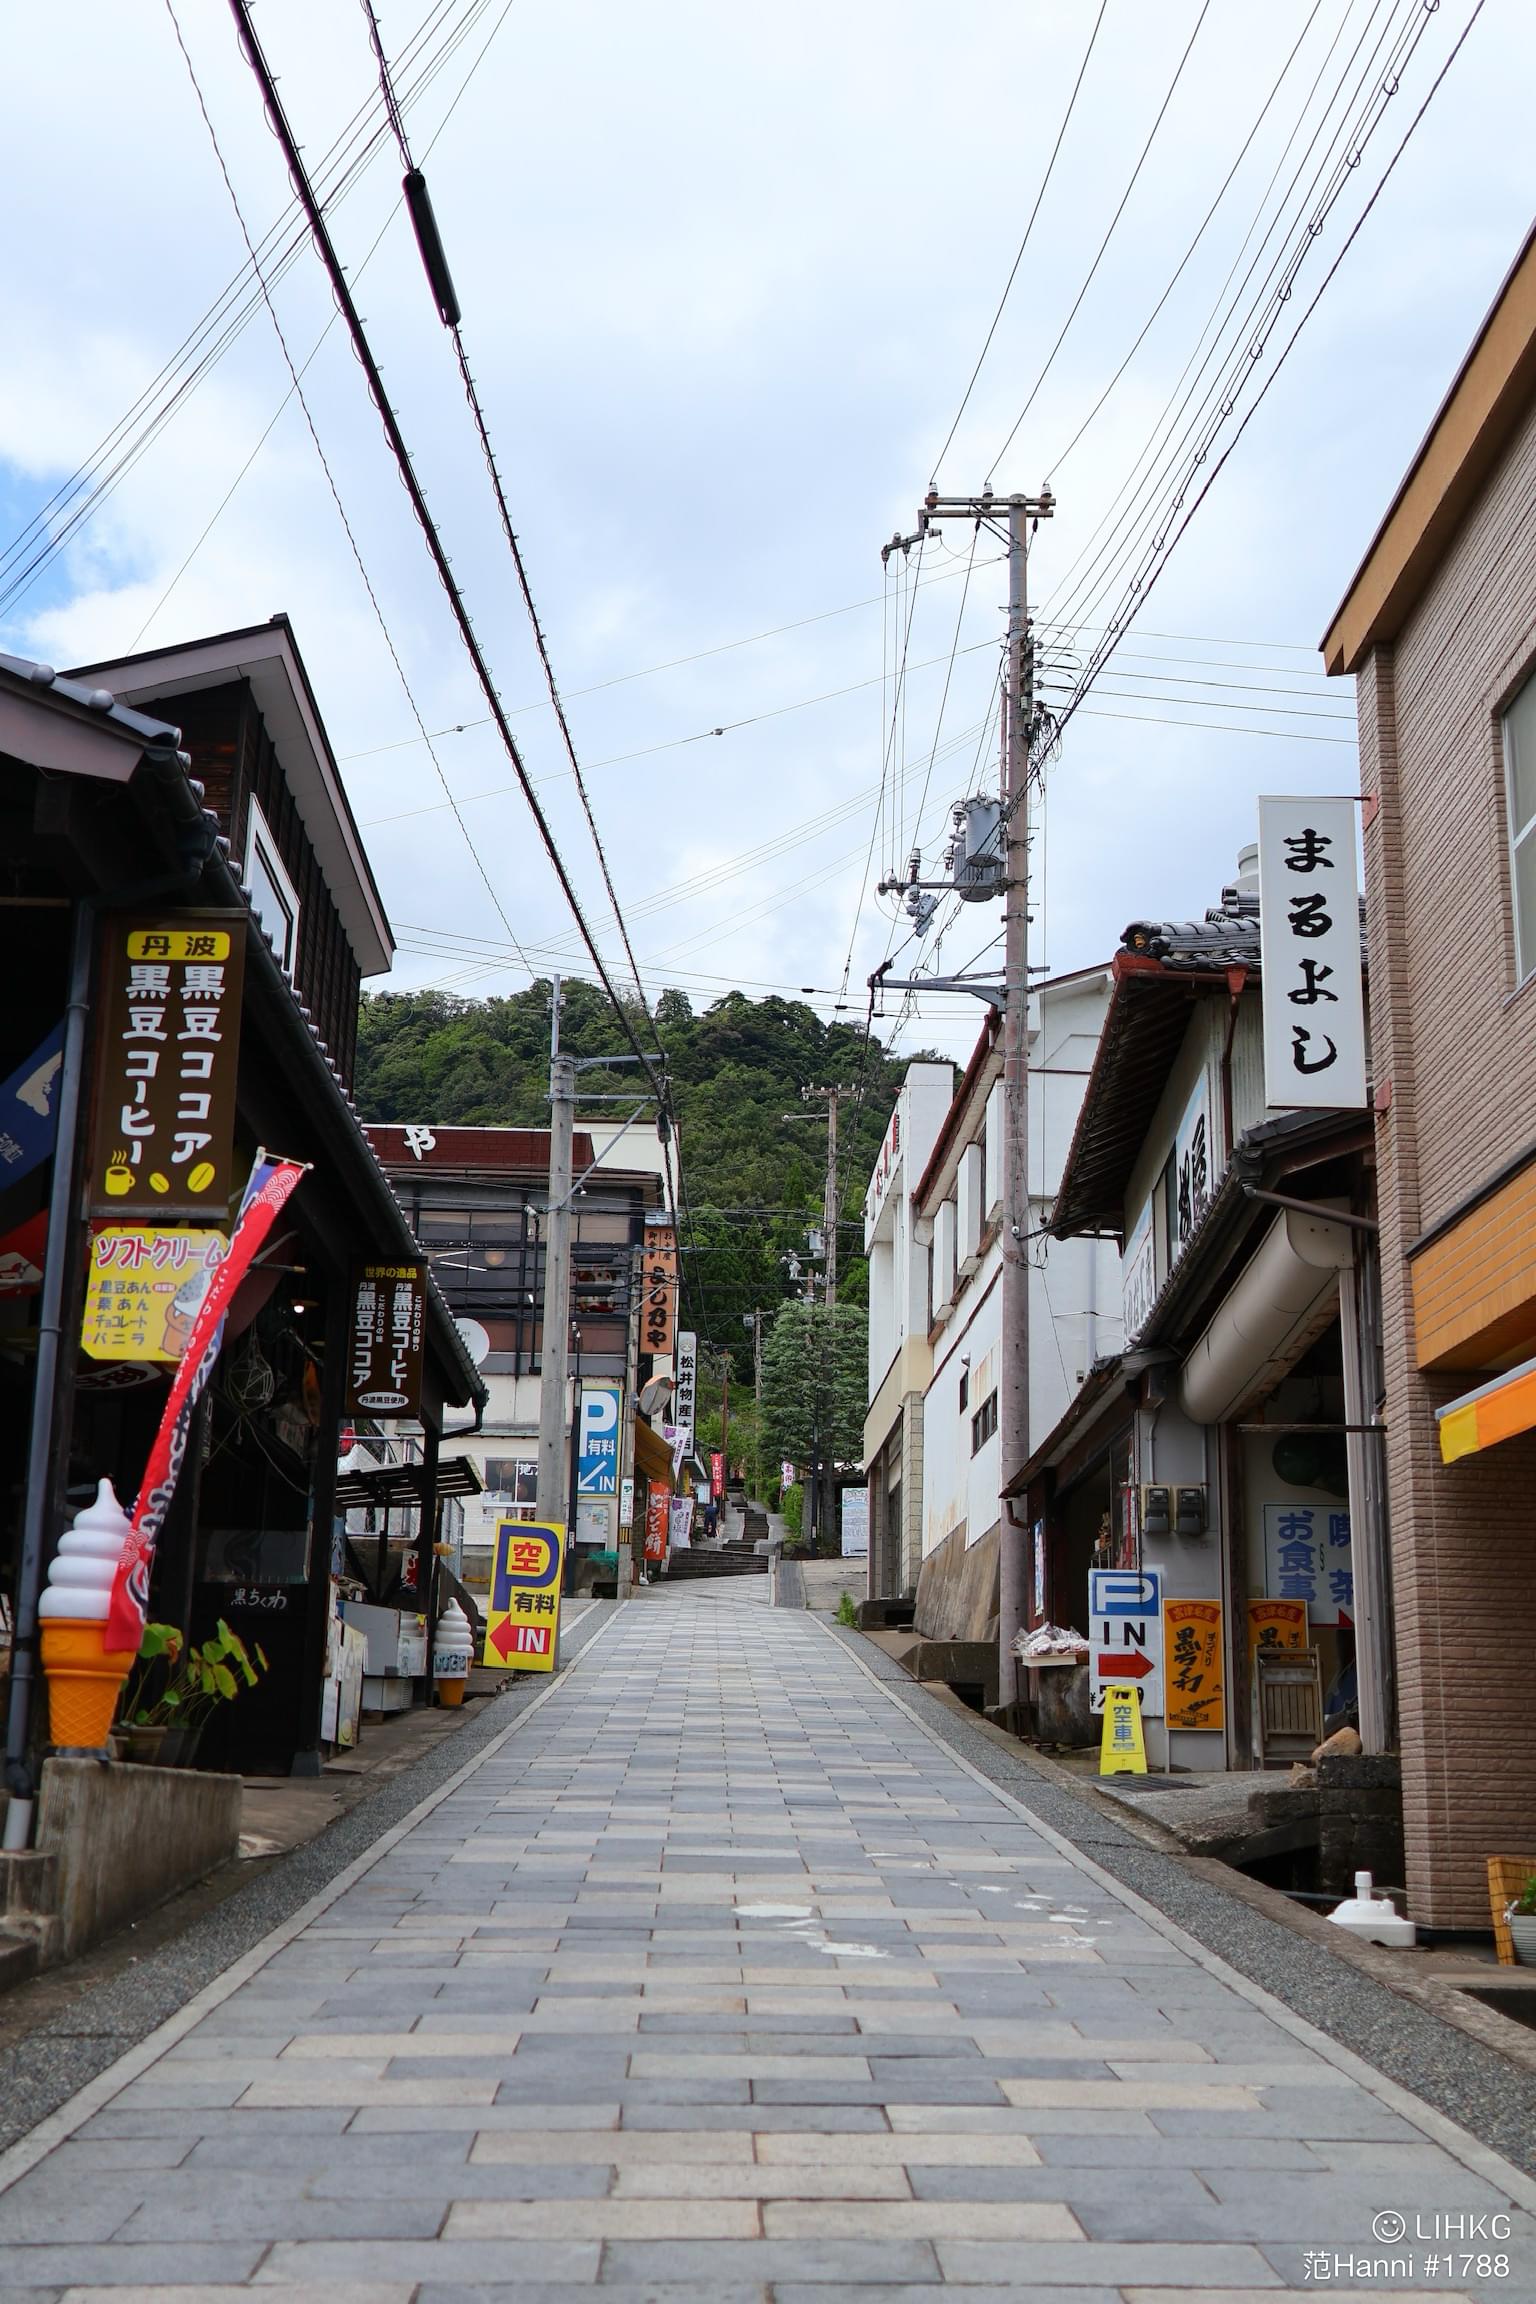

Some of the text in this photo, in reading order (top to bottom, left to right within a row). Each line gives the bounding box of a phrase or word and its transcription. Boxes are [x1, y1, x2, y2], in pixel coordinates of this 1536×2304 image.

[141, 935, 217, 957] 丹波
[1283, 828, 1339, 1074] まるよし
[121, 965, 172, 1165] 黒豆コーヒー
[171, 965, 226, 1164] 黒豆ココア
[403, 1126, 436, 1161] や
[97, 1235, 225, 1270] ソフトクリーム
[93, 1333, 145, 1346] バニラ
[95, 1315, 148, 1329] チョコレート
[352, 1291, 377, 1389] 黒豆ココア
[391, 1291, 413, 1390] 黒豆コーヒー
[579, 1391, 617, 1457] P
[588, 1438, 615, 1456] 有料
[599, 1475, 615, 1492] IN
[492, 1524, 560, 1612] P
[511, 1542, 542, 1573] 空
[1277, 1510, 1317, 1600] お食事
[231, 1587, 287, 1609] 黒ちくわ
[514, 1592, 555, 1615] 有料
[1096, 1576, 1155, 1612] P
[517, 1627, 545, 1652] IN
[1104, 1622, 1146, 1646] IN
[1172, 1626, 1204, 1693] 黒ちくわ
[1113, 1706, 1132, 1742] 空車
